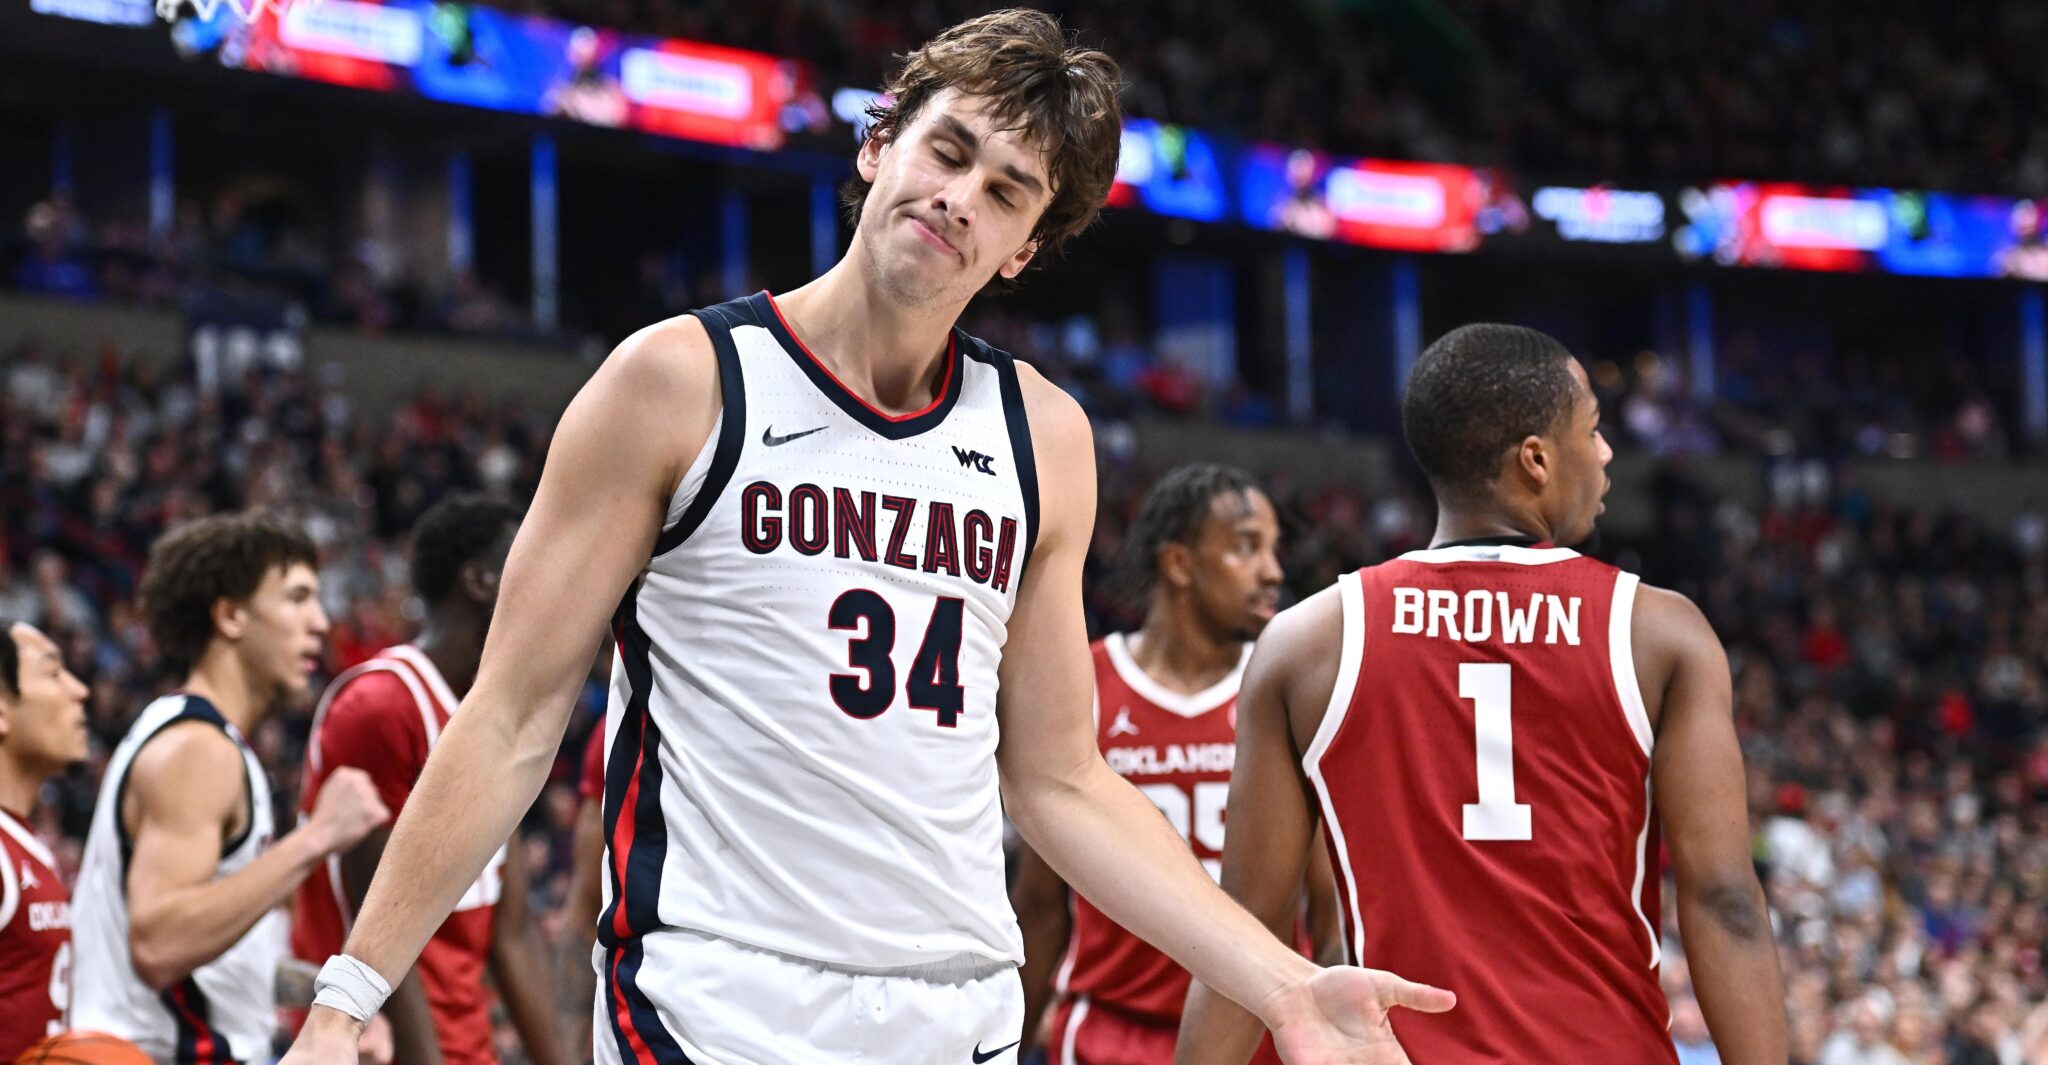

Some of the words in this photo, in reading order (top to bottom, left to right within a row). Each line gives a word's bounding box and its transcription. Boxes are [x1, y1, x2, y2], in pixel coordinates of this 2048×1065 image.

[951, 445, 997, 476] WCC
[741, 480, 1017, 594] GONZAGA
[827, 588, 965, 728] 34
[1392, 587, 1582, 646] BROWN
[1458, 662, 1533, 841] 1
